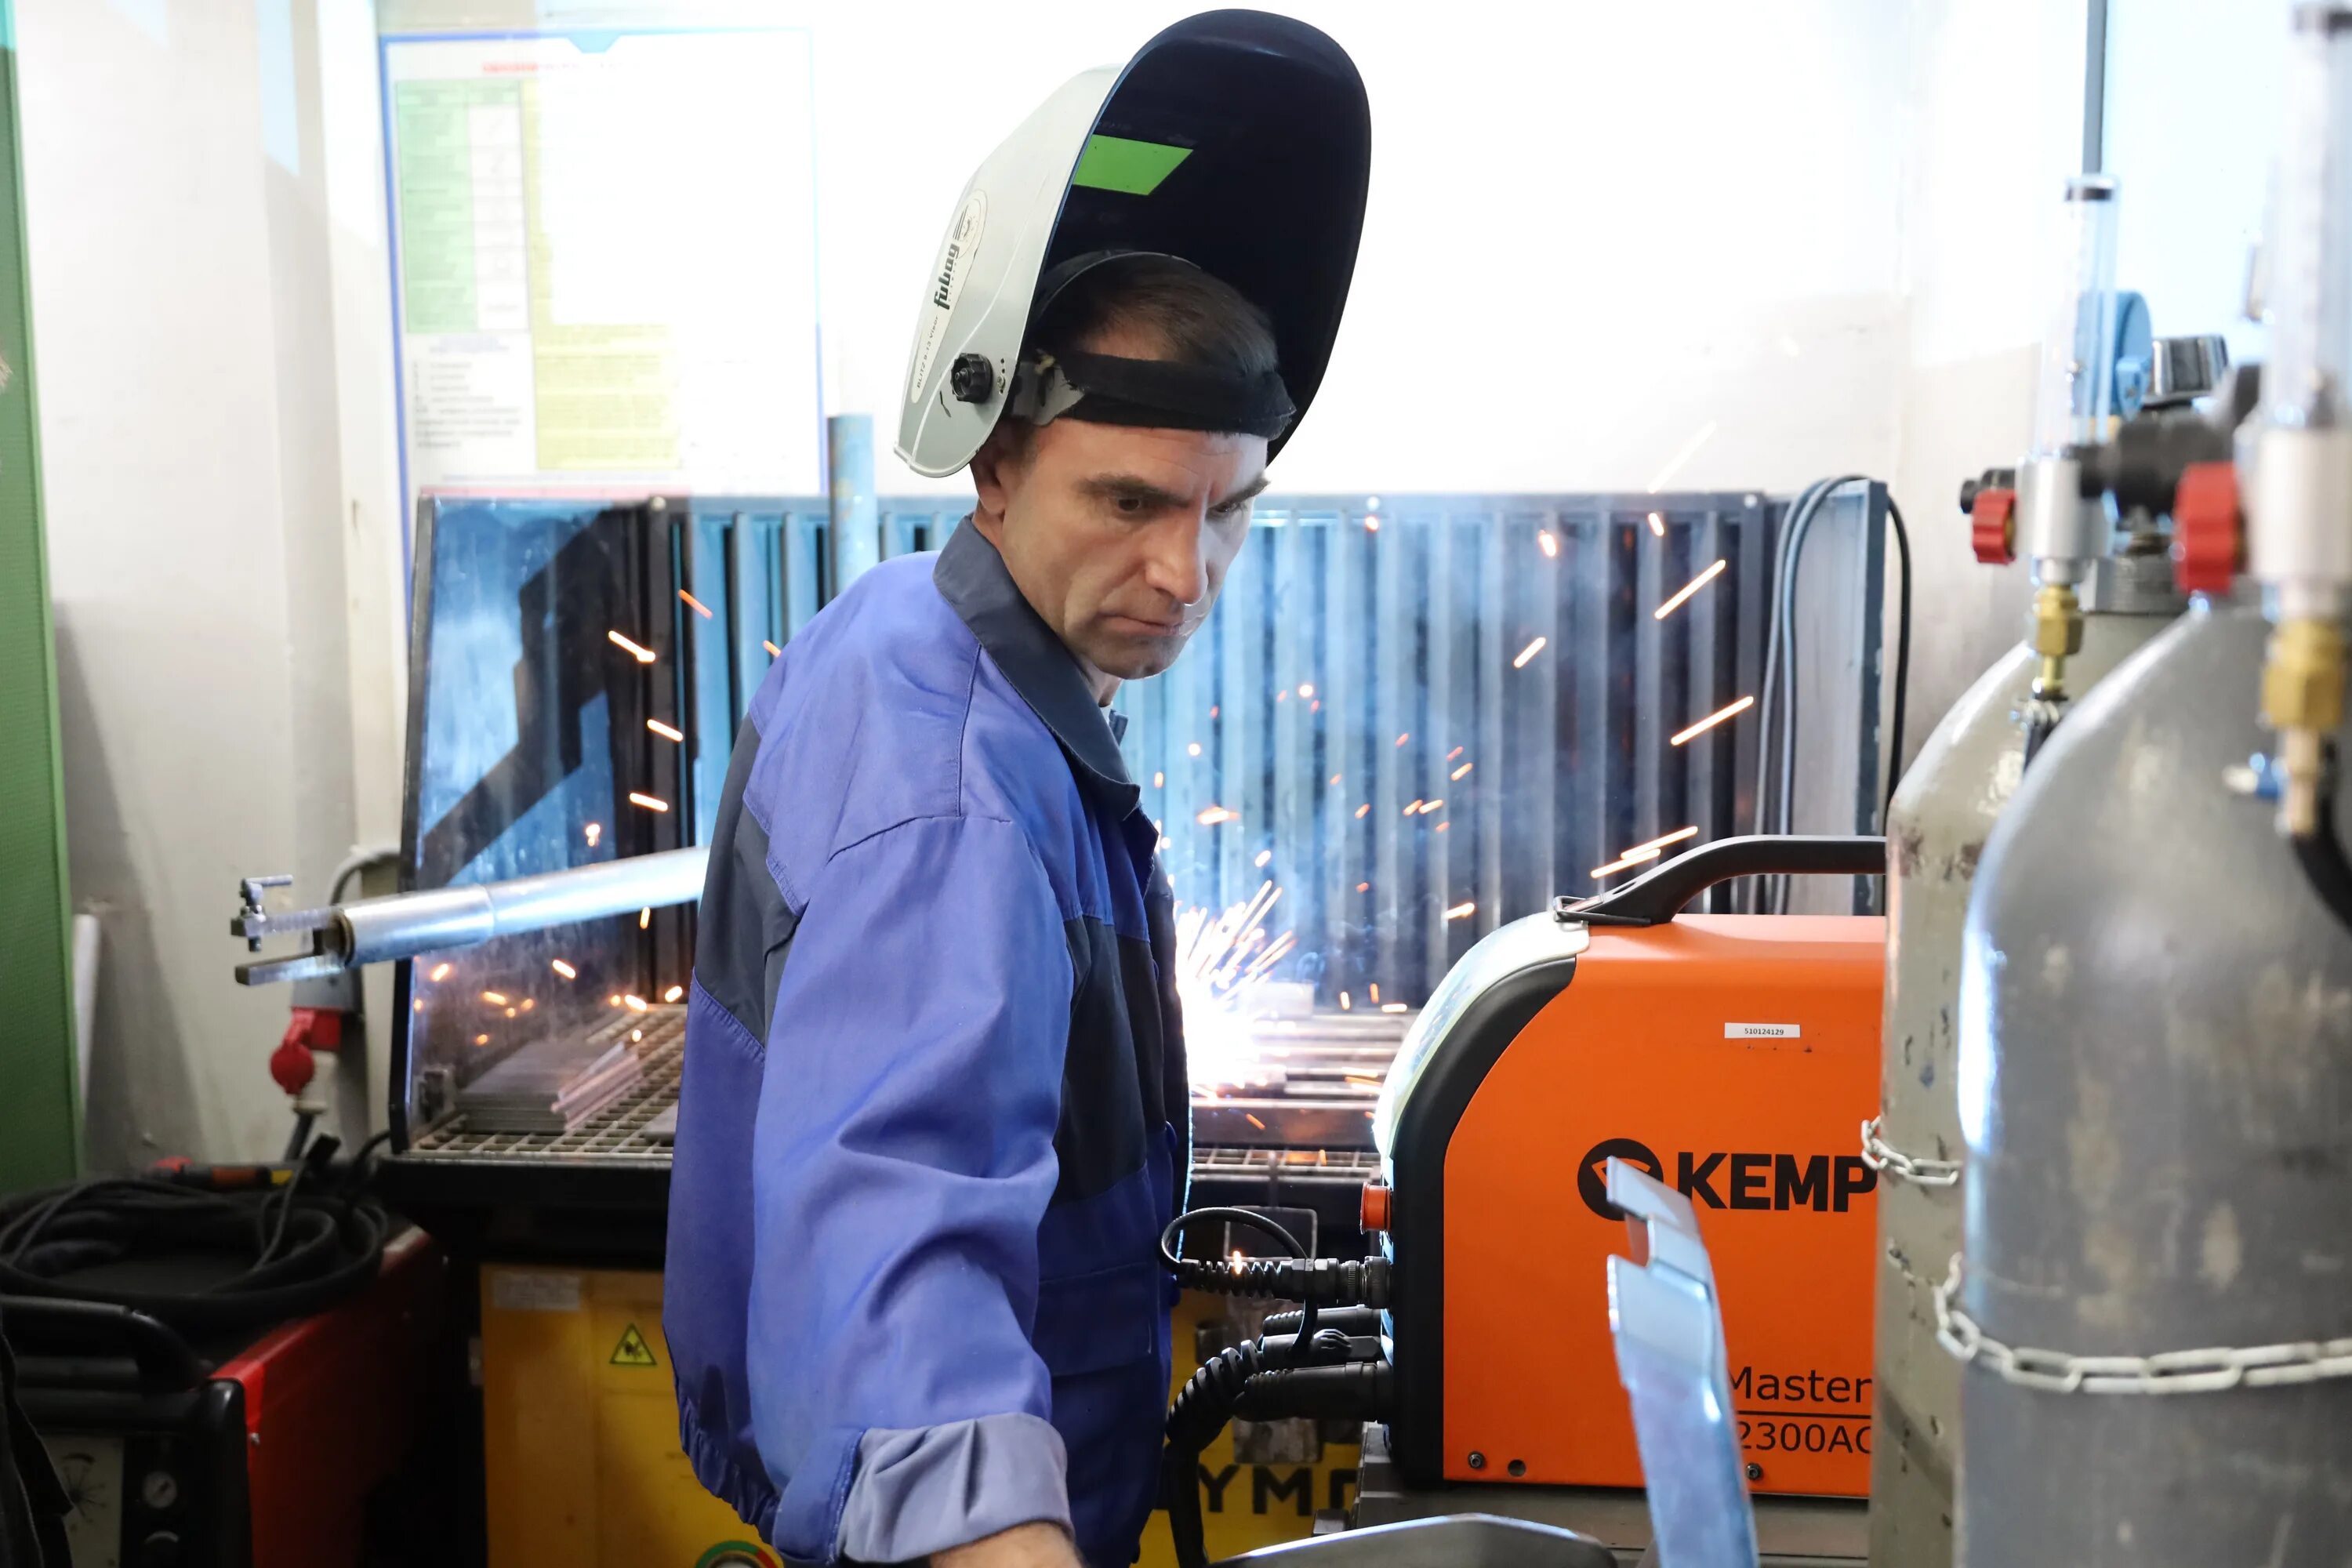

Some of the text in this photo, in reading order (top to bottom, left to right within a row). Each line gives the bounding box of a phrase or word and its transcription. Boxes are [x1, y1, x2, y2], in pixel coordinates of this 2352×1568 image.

[934, 243, 960, 310] fubag
[916, 361, 925, 389] BLITZ
[1678, 1152, 1878, 1212] KEMP
[1728, 1367, 1873, 1403] Master
